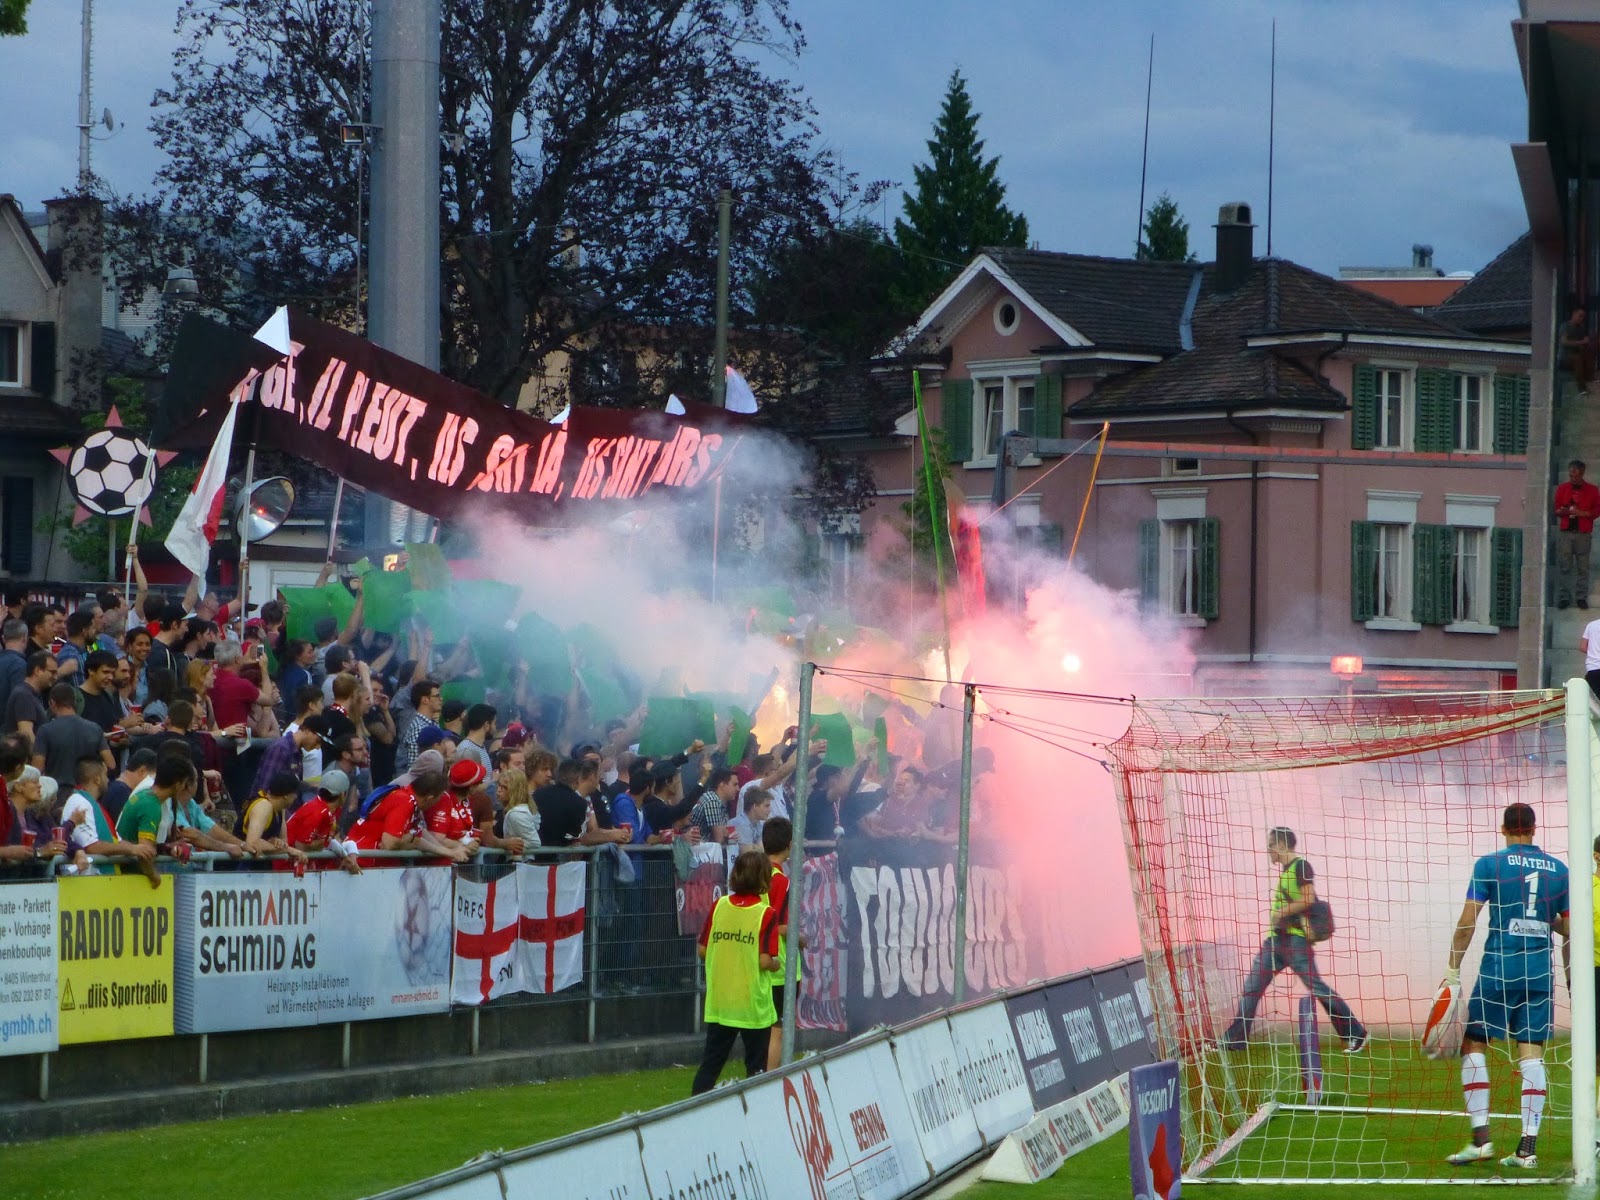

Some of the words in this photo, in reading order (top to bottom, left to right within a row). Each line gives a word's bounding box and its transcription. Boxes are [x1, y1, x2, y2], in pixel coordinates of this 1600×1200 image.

[308, 357, 346, 431] IL
[428, 412, 479, 486] ILS
[571, 437, 617, 500] ILS
[1508, 855, 1556, 872] GUATELLI
[23, 898, 51, 913] Parkett
[1525, 872, 1539, 917] 1
[14, 921, 51, 938] Vorhänge
[61, 907, 123, 961] RADIO
[130, 906, 168, 957] TOP
[291, 933, 316, 969] AG
[4, 973, 18, 985] 8405
[20, 971, 51, 983] Winterthur
[267, 975, 349, 995] Heizungs-Installationen
[111, 979, 167, 1010] Sportradio
[267, 1002, 280, 1014] und
[282, 996, 344, 1013] Wärmetechnische
[347, 992, 375, 1010] Anlagen
[391, 987, 438, 1004] ammann-schmid.ch
[849, 1101, 889, 1152] BERNINA
